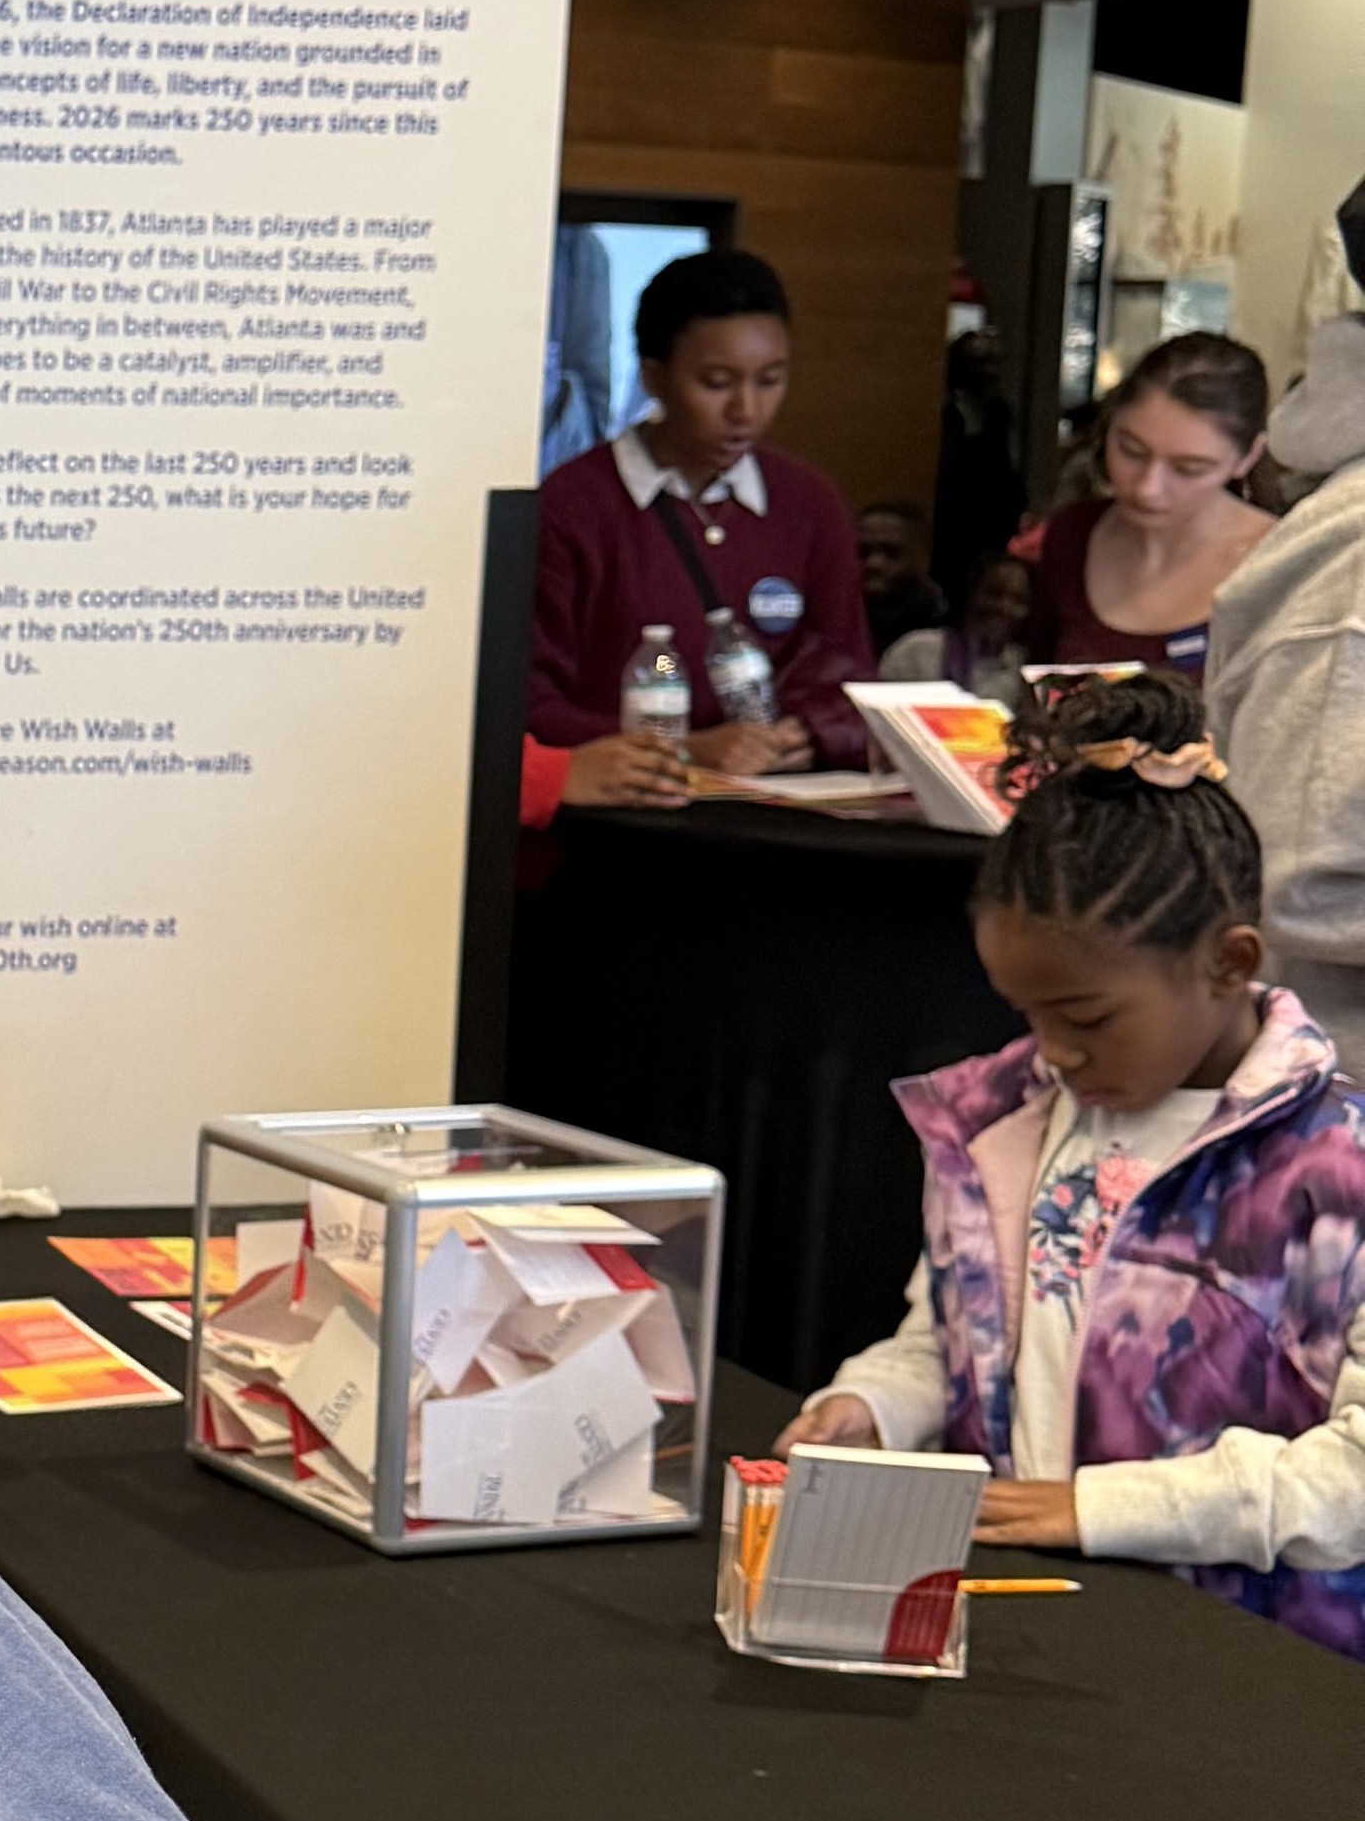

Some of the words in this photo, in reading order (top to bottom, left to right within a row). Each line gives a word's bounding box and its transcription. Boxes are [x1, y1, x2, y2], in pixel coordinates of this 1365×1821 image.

[26, 0, 67, 23] the
[71, 0, 212, 25] Declaration
[216, 3, 244, 26] of
[247, 5, 419, 32] Independence
[423, 10, 470, 32] laid
[18, 35, 92, 58] vision
[96, 34, 133, 58] for
[135, 41, 153, 59] a
[156, 41, 209, 61] new
[212, 40, 291, 62] nation
[294, 42, 414, 68] grounded
[417, 45, 442, 65] in
[84, 69, 112, 94] of
[116, 71, 161, 95] life,
[166, 73, 252, 100] liberty,
[256, 76, 304, 97] and
[308, 76, 348, 98] the
[352, 77, 438, 104] pursuit
[442, 79, 470, 100] of
[58, 105, 121, 129] 2026
[125, 109, 200, 130] marks
[204, 107, 254, 132] 250
[258, 115, 323, 137] years
[327, 114, 390, 134] since
[394, 114, 439, 135] this
[69, 143, 183, 165] occasion.
[29, 210, 53, 232] in
[58, 209, 116, 236] 1837,
[119, 212, 208, 235] Atlanta
[212, 215, 254, 235] has
[258, 215, 340, 241] played
[343, 219, 360, 237] a
[363, 218, 433, 242] major
[40, 246, 124, 272] history
[127, 245, 156, 269] of
[158, 247, 199, 270] the
[203, 248, 284, 271] United
[287, 247, 368, 272] States.
[372, 248, 437, 273] From
[17, 280, 67, 302] War
[71, 282, 98, 302] to
[102, 282, 143, 304] the
[146, 280, 200, 304] Civil
[203, 280, 280, 309] Rights
[284, 283, 415, 307] Movement,
[95, 316, 119, 336] in
[122, 315, 232, 341] between,
[237, 316, 326, 339] Atlanta
[330, 321, 376, 341] was
[380, 321, 427, 340] and
[32, 350, 59, 371] to
[62, 349, 95, 371] be
[97, 353, 114, 371] a
[118, 350, 217, 376] catalyst,
[221, 350, 333, 376] amplifier,
[336, 355, 384, 374] and
[63, 455, 96, 473] on
[100, 452, 140, 474] the
[144, 452, 187, 475] last
[192, 451, 240, 474] 250
[243, 457, 307, 478] years
[311, 456, 358, 475] and
[361, 454, 412, 475] look
[5, 485, 46, 508] the
[49, 487, 102, 507] next
[106, 484, 159, 509] 250,
[165, 485, 223, 508] what
[227, 488, 250, 508] is
[253, 491, 307, 513] your
[310, 488, 372, 510] hope
[376, 487, 412, 509] for
[13, 517, 98, 541] future?
[34, 589, 73, 609] are
[76, 587, 220, 609] coordinated
[223, 590, 299, 609] across
[303, 589, 344, 609] the
[347, 588, 426, 610] United
[17, 619, 57, 641] the
[61, 619, 155, 642] nation's
[158, 618, 230, 642] 250th
[233, 623, 370, 645] anniversary
[374, 621, 405, 646] by
[19, 719, 79, 741] Wish
[83, 720, 147, 741] Walls
[151, 721, 175, 741] at
[19, 916, 73, 938] wish
[76, 916, 150, 938] online
[153, 917, 177, 937] at
